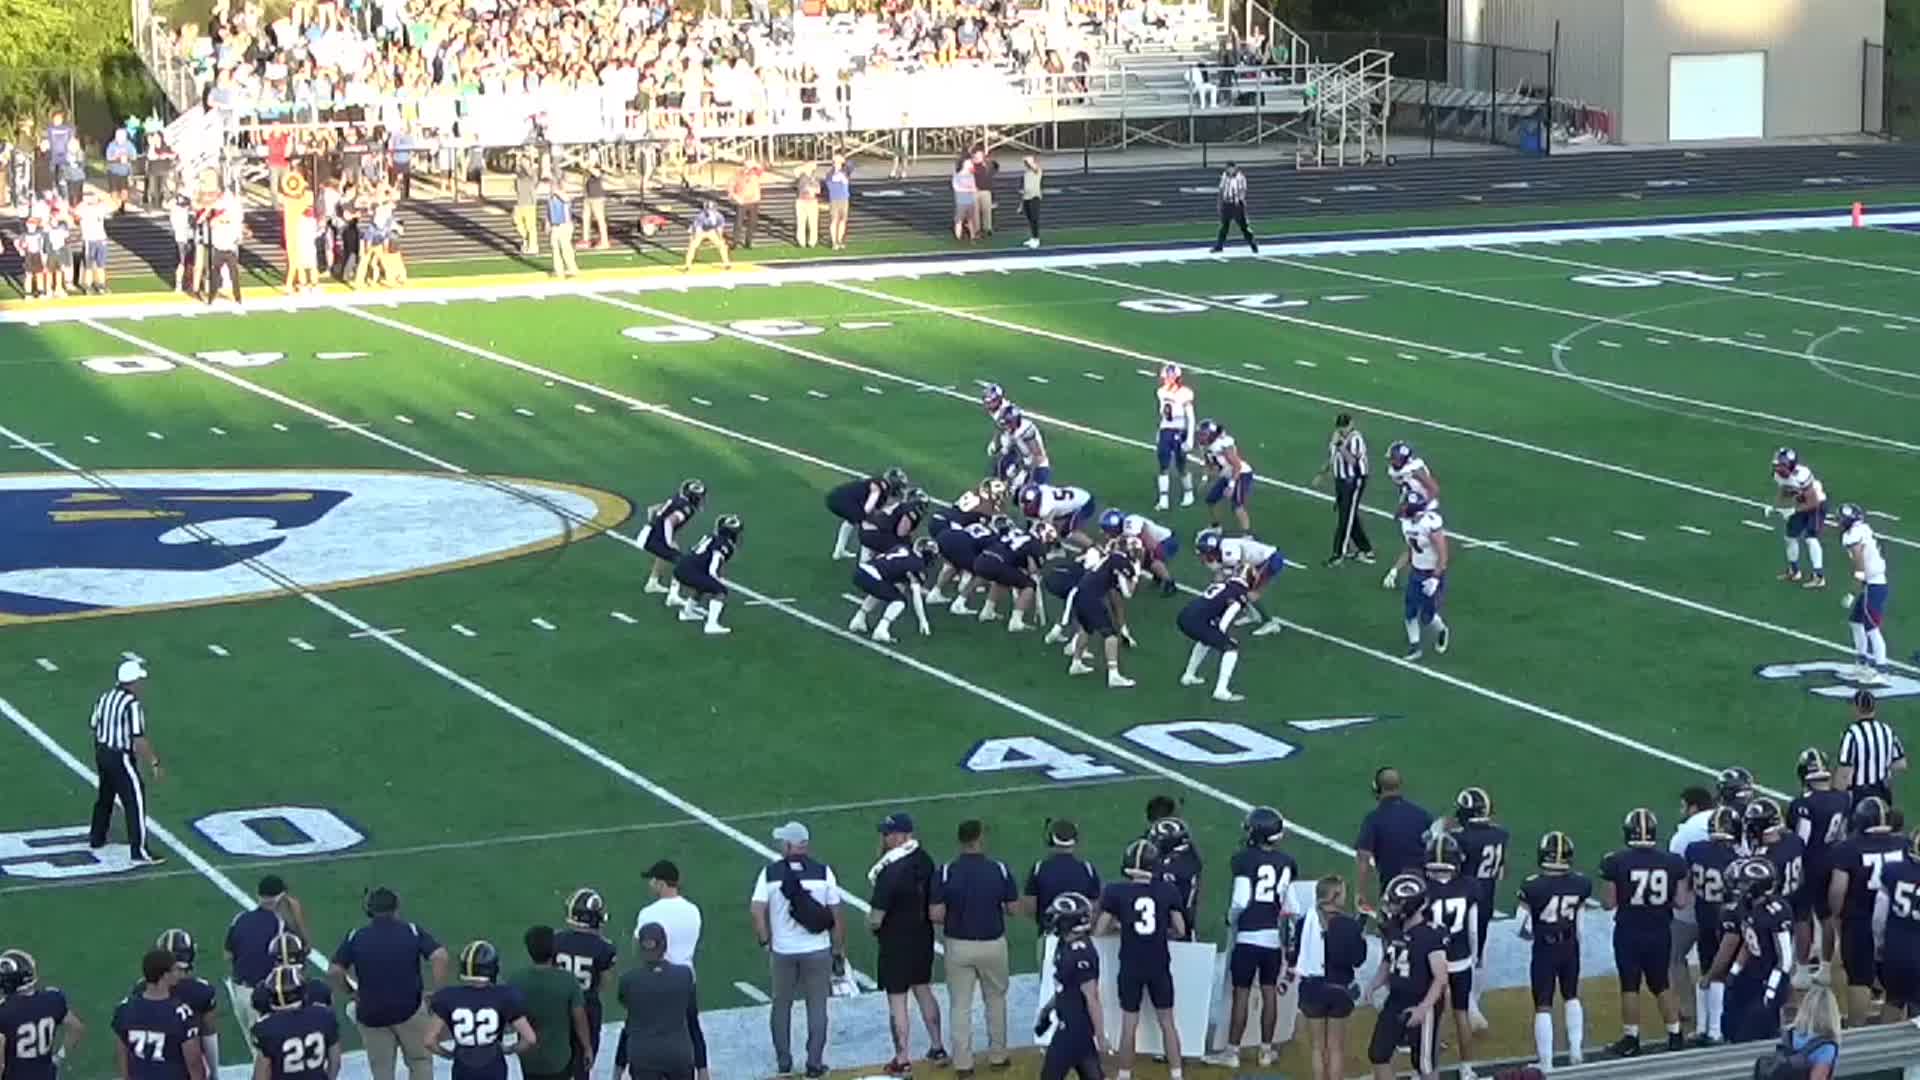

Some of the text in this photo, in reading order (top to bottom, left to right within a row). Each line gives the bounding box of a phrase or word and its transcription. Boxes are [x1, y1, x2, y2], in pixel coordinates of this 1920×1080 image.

[966, 720, 1296, 780] 40
[1629, 869, 1669, 906] 79
[1133, 896, 1157, 936] 3
[1430, 897, 1468, 935] 17
[16, 1016, 56, 1059] 20
[128, 1029, 166, 1062] 77
[451, 1007, 500, 1047] 22
[282, 1031, 326, 1074] 23
